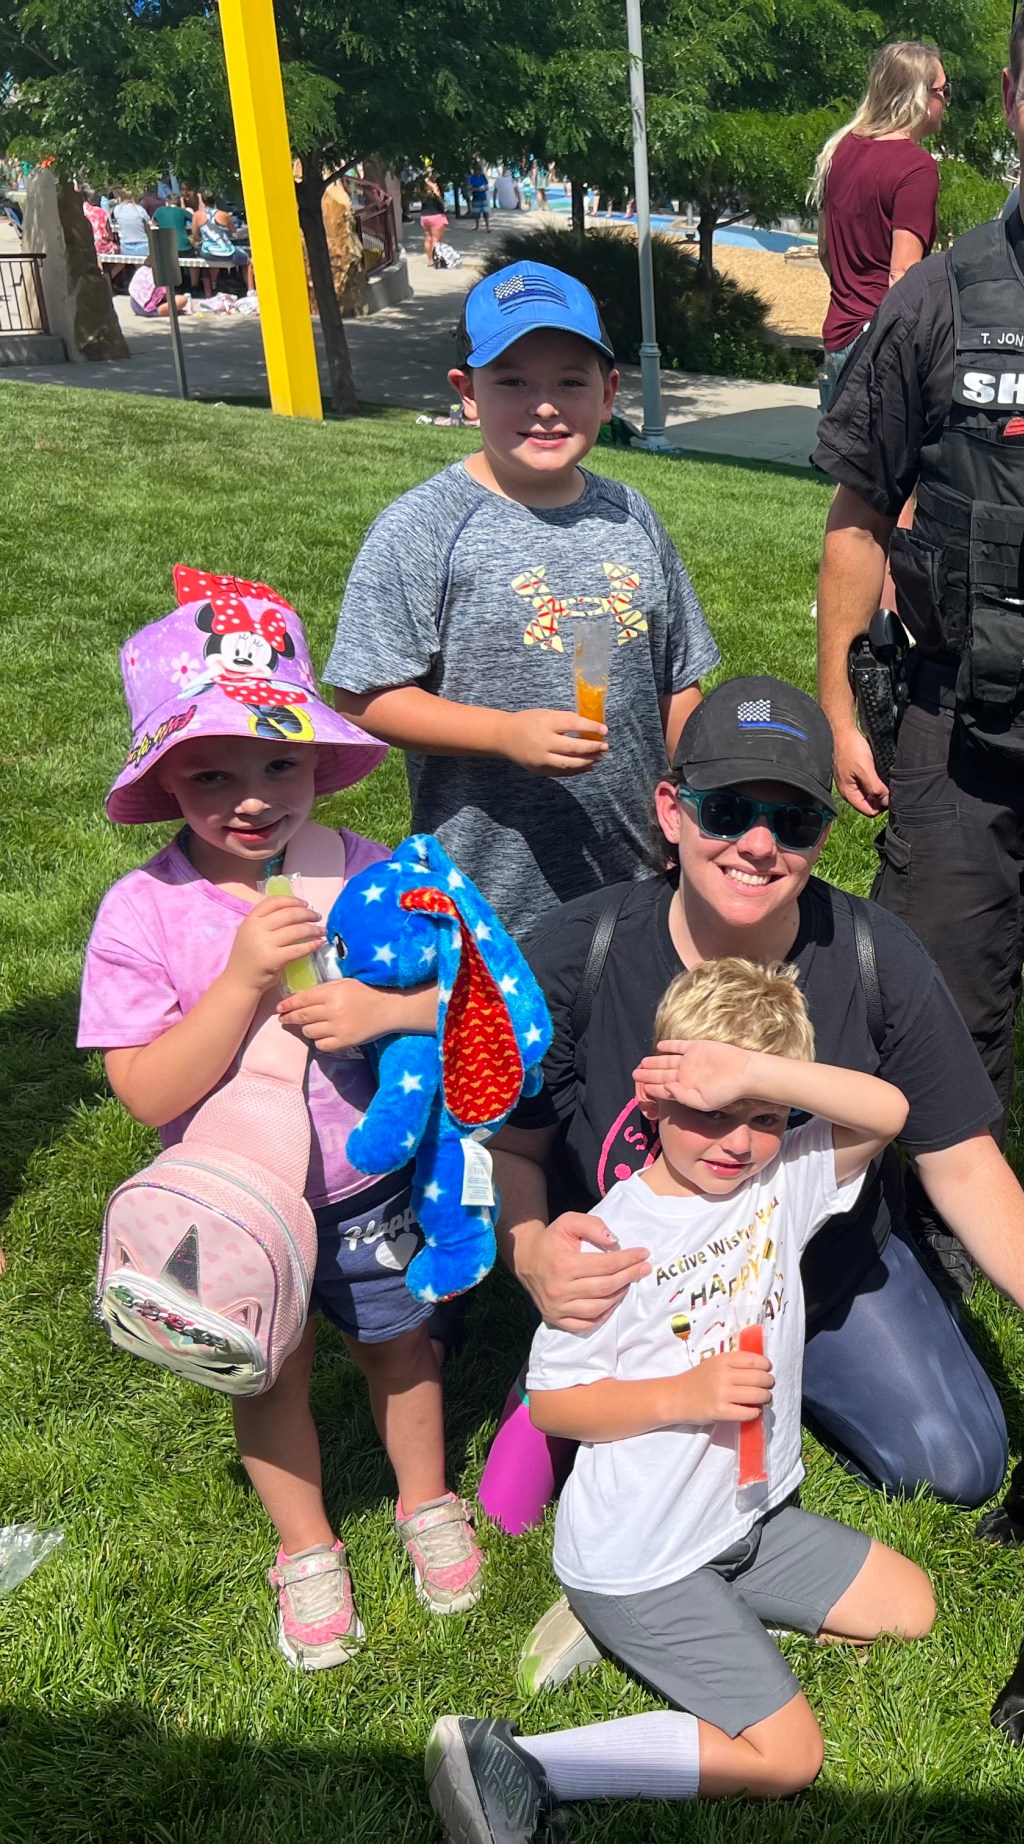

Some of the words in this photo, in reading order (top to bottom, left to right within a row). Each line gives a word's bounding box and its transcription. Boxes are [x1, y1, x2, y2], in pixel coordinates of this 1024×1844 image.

[981, 332, 991, 345] T.
[343, 1207, 418, 1252] Happ
[655, 1251, 708, 1287] Active
[707, 1219, 758, 1259] Wishe
[689, 1252, 762, 1312] HAPPY
